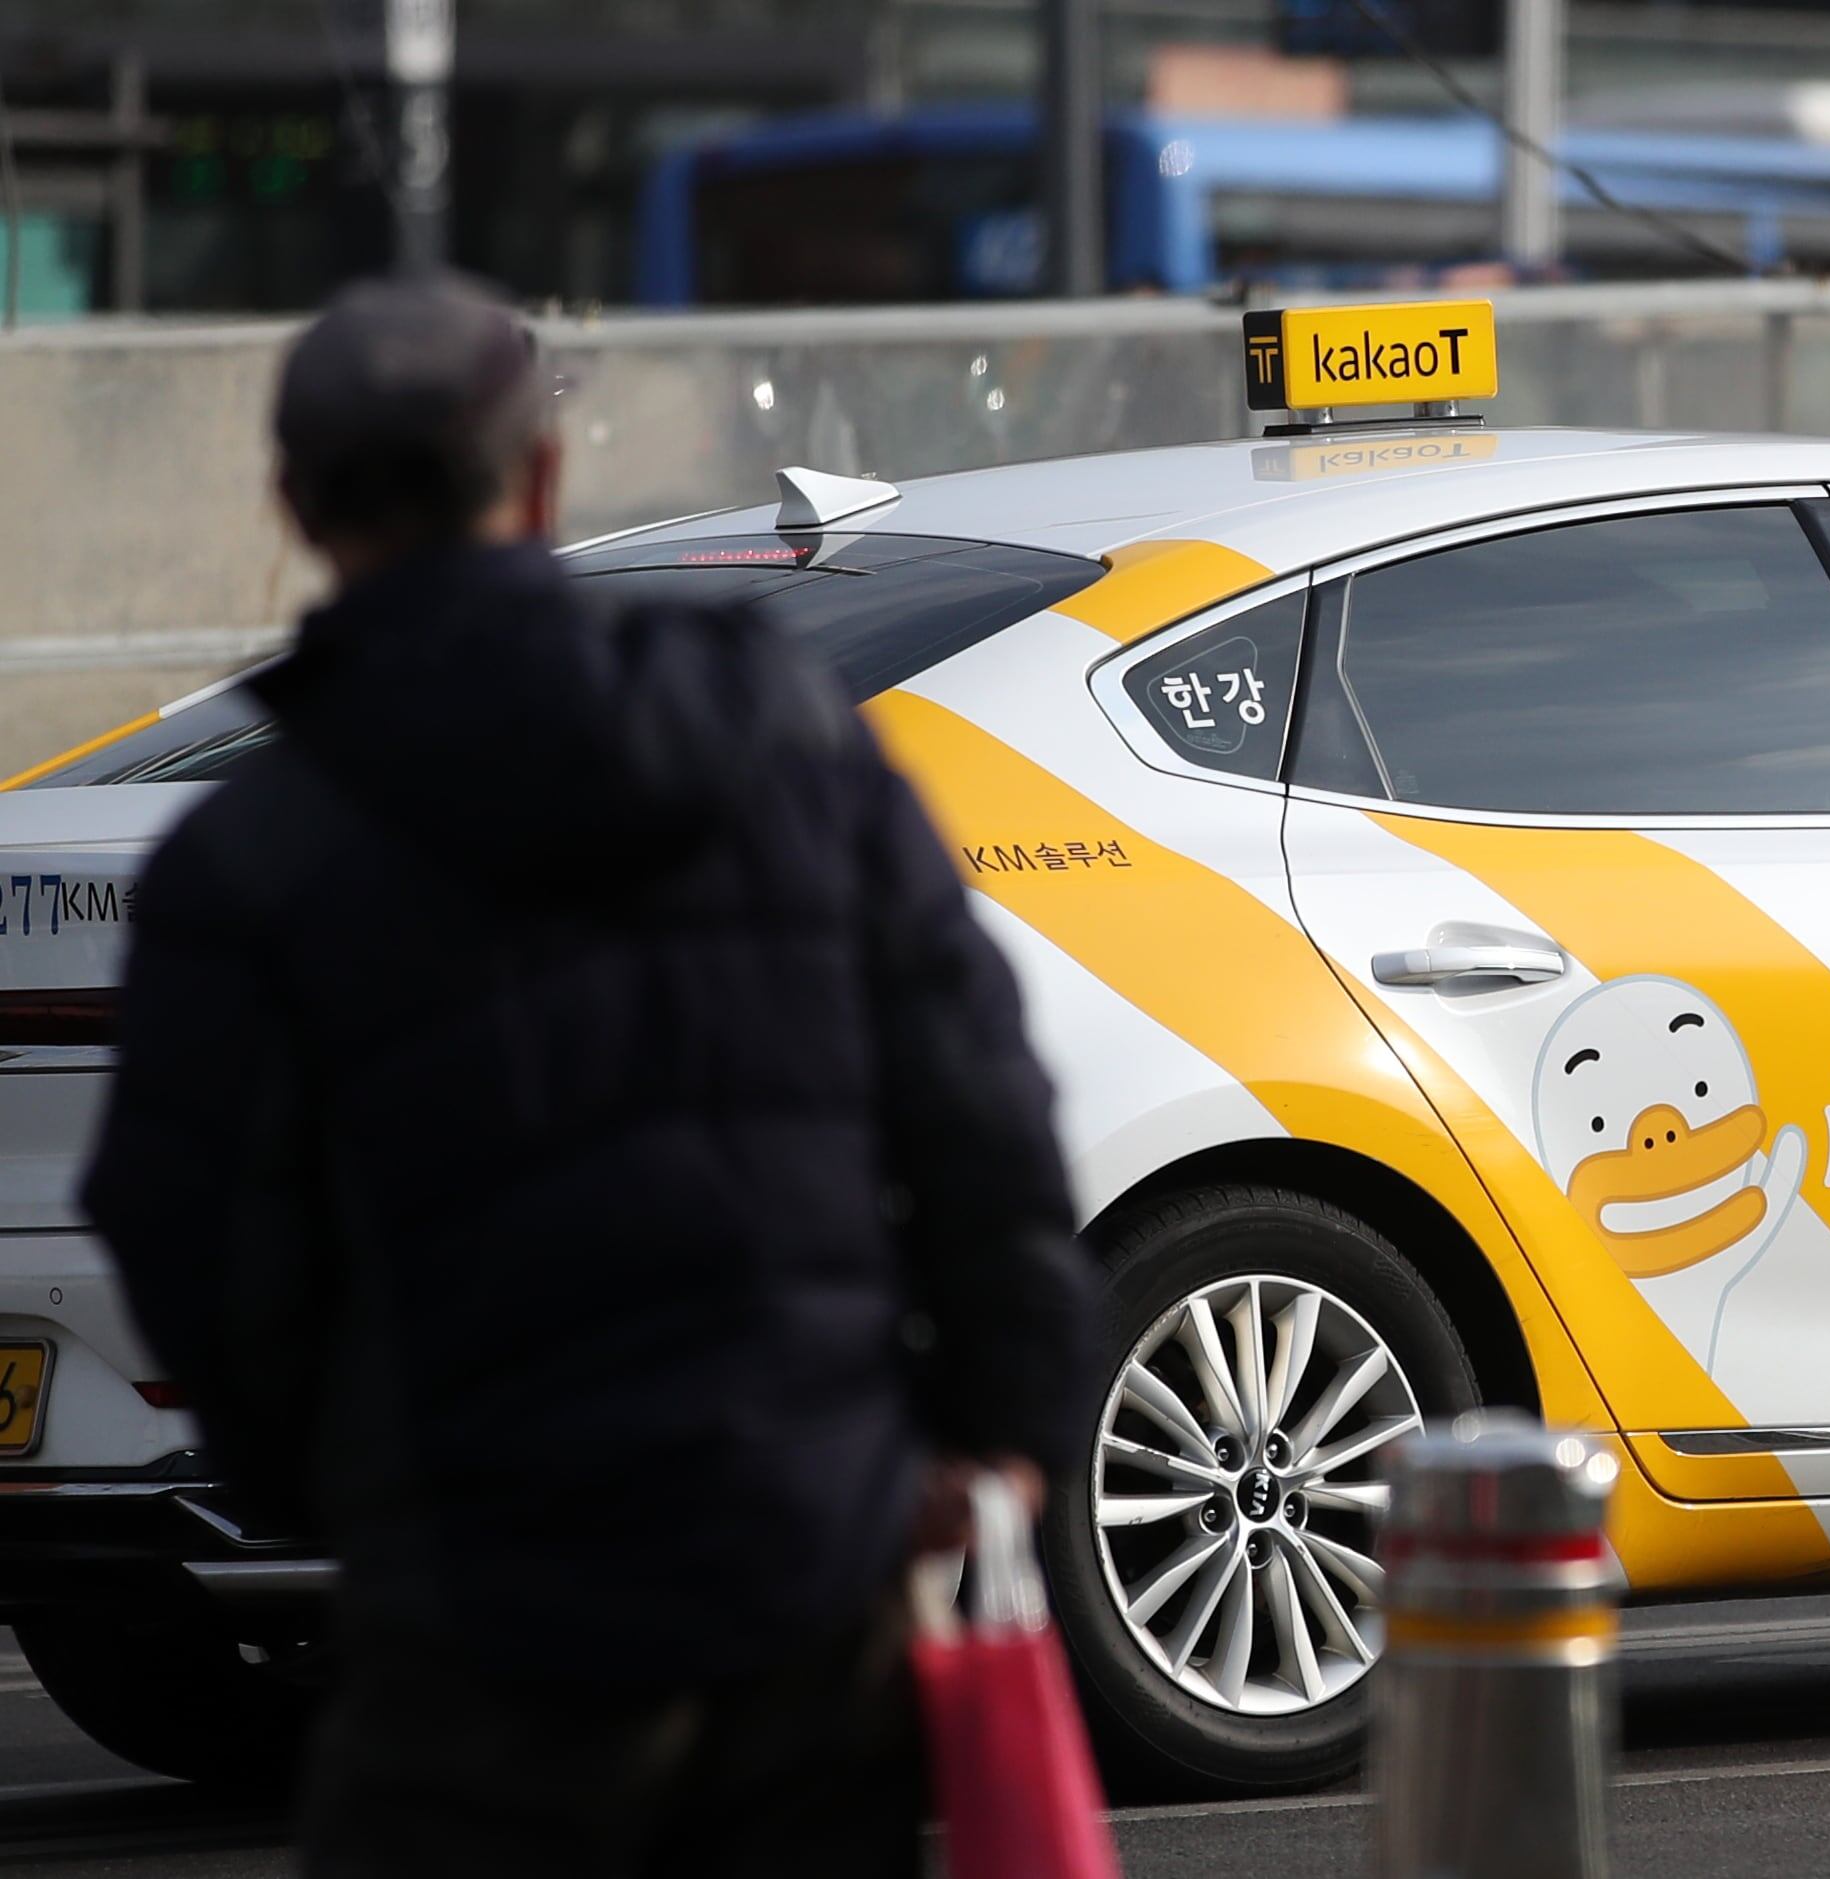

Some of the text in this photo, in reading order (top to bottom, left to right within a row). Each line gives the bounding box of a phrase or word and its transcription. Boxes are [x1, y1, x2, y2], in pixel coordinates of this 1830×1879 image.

[1160, 667, 1267, 730] 한강
[963, 840, 1132, 873] KM솔루션
[1250, 1472, 1271, 1516] KIA
